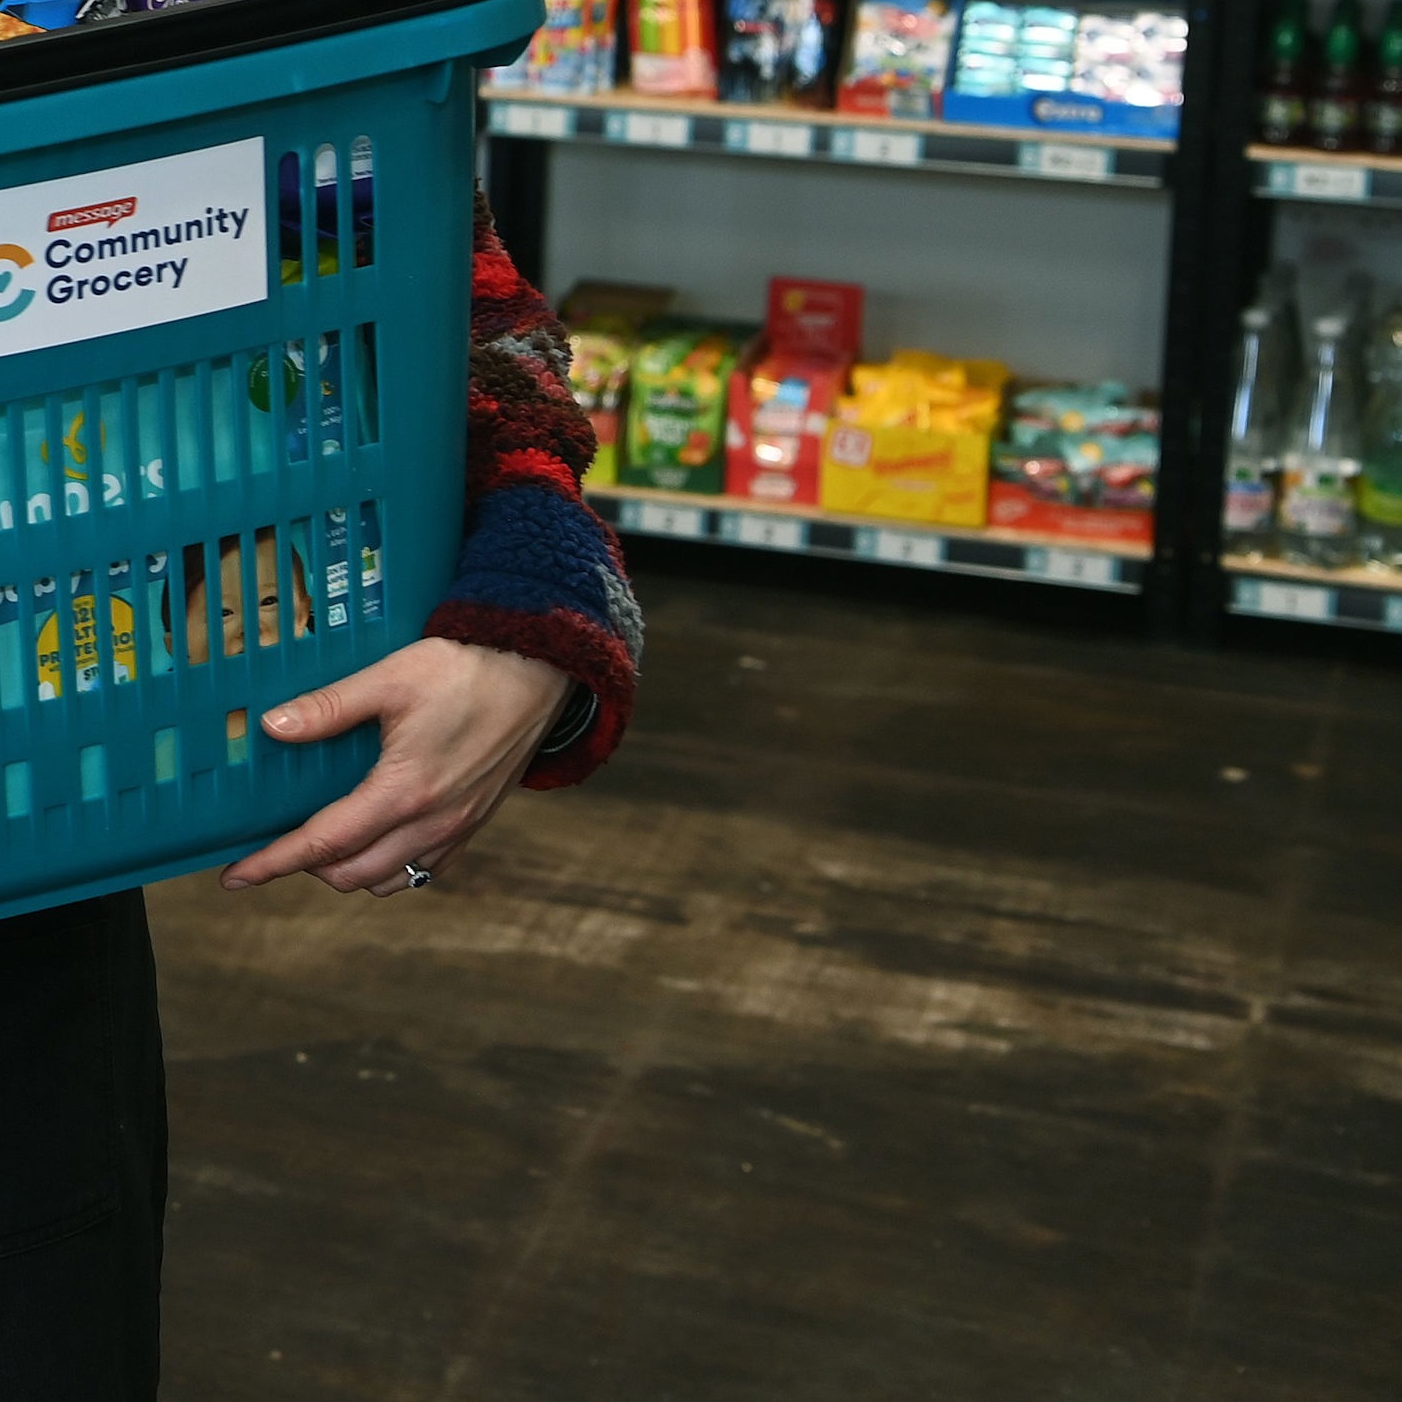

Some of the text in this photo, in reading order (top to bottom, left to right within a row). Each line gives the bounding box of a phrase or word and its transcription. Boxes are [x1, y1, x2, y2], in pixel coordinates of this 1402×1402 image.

[45, 206, 250, 269] Community
[53, 200, 135, 228] message
[46, 257, 189, 305] Grocery
